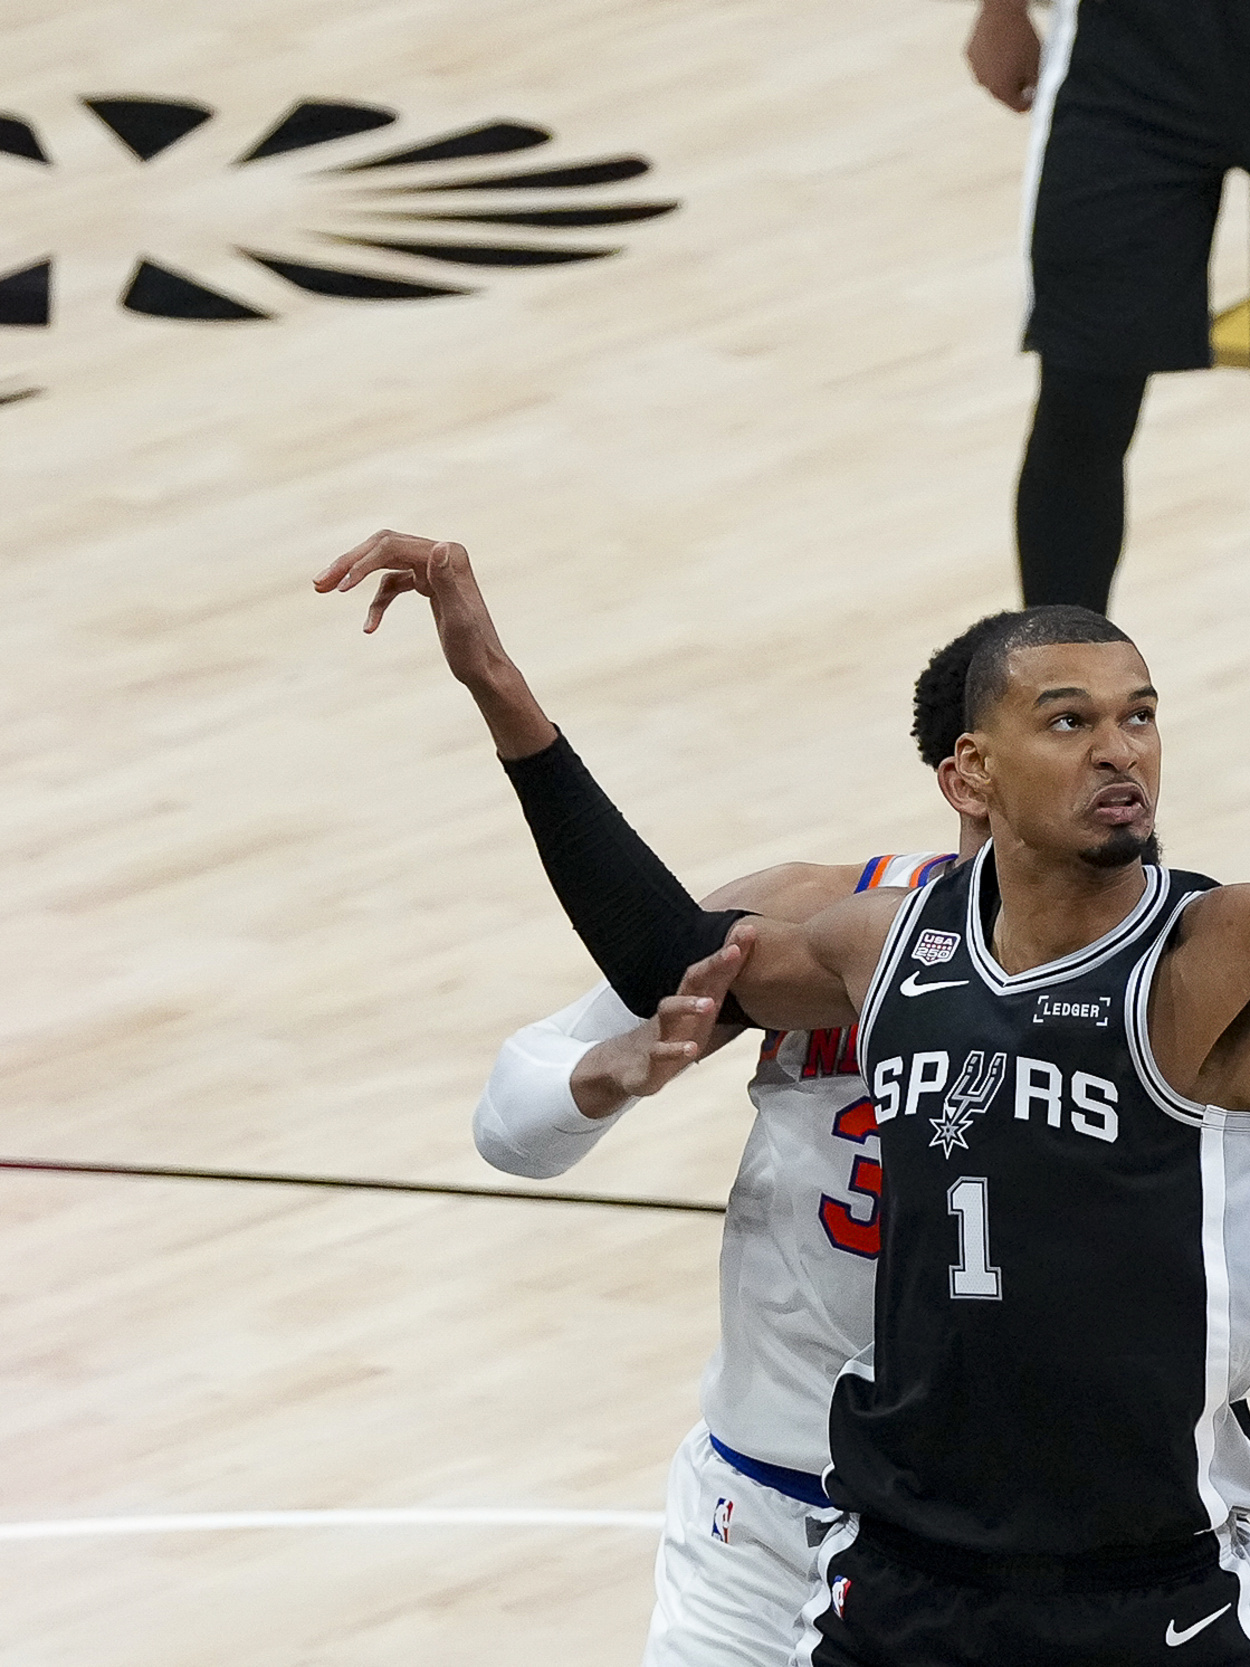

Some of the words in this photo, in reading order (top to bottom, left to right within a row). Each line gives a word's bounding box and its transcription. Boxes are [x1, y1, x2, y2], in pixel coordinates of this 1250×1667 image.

[923, 933, 953, 946] USA
[916, 947, 951, 959] 250
[1042, 1002, 1100, 1020] LEDGER
[874, 1050, 1119, 1150] SPURS
[946, 1176, 1003, 1302] 1
